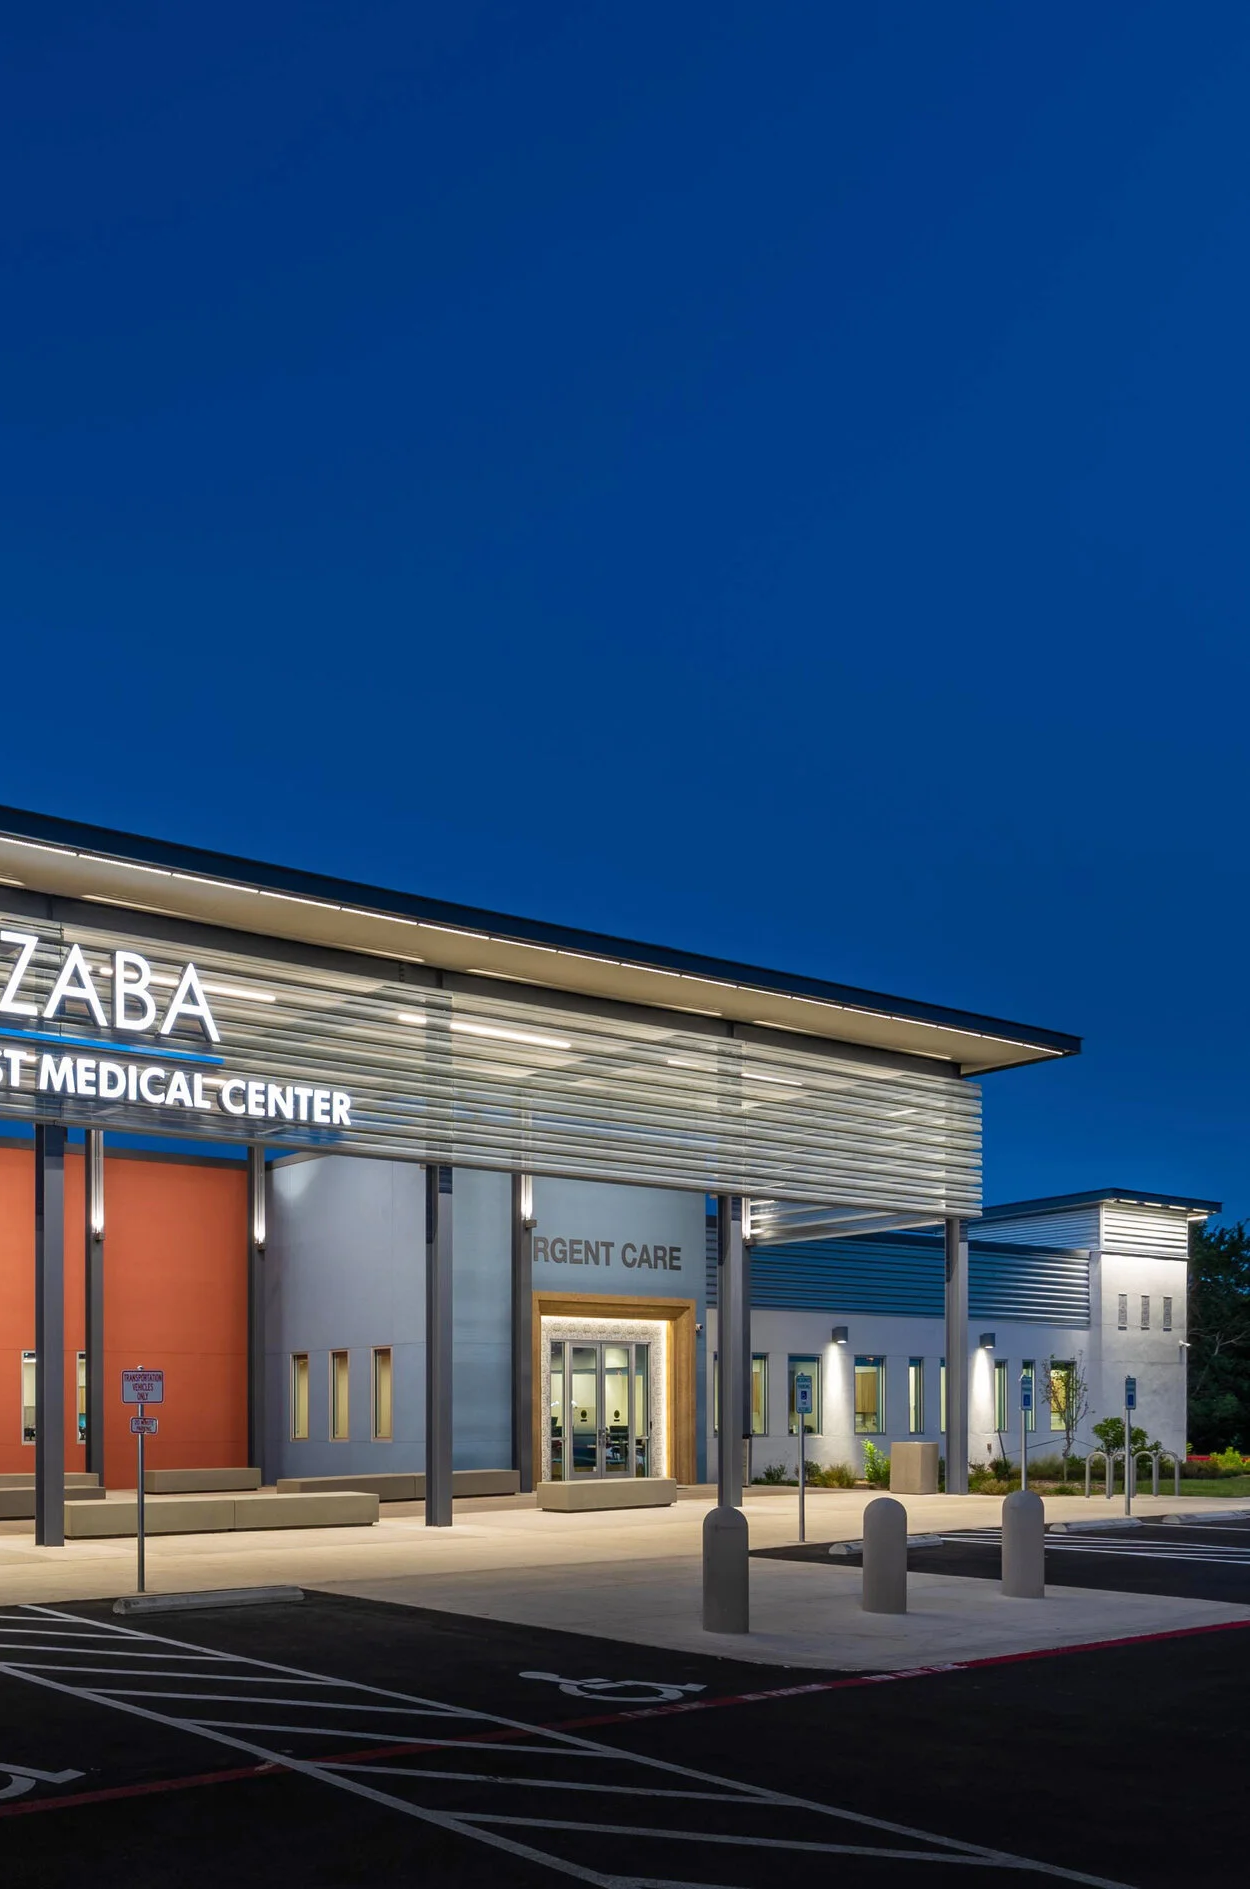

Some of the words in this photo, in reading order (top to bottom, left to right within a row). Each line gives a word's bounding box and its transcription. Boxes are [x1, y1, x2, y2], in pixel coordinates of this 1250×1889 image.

[37, 1054, 211, 1108] MEDICAL
[219, 1079, 351, 1125] CENTER
[533, 1236, 615, 1266] RGENT
[621, 1243, 682, 1271] CARE
[124, 1373, 162, 1382] TRANSPORTATION
[132, 1383, 154, 1391] VEHICLES
